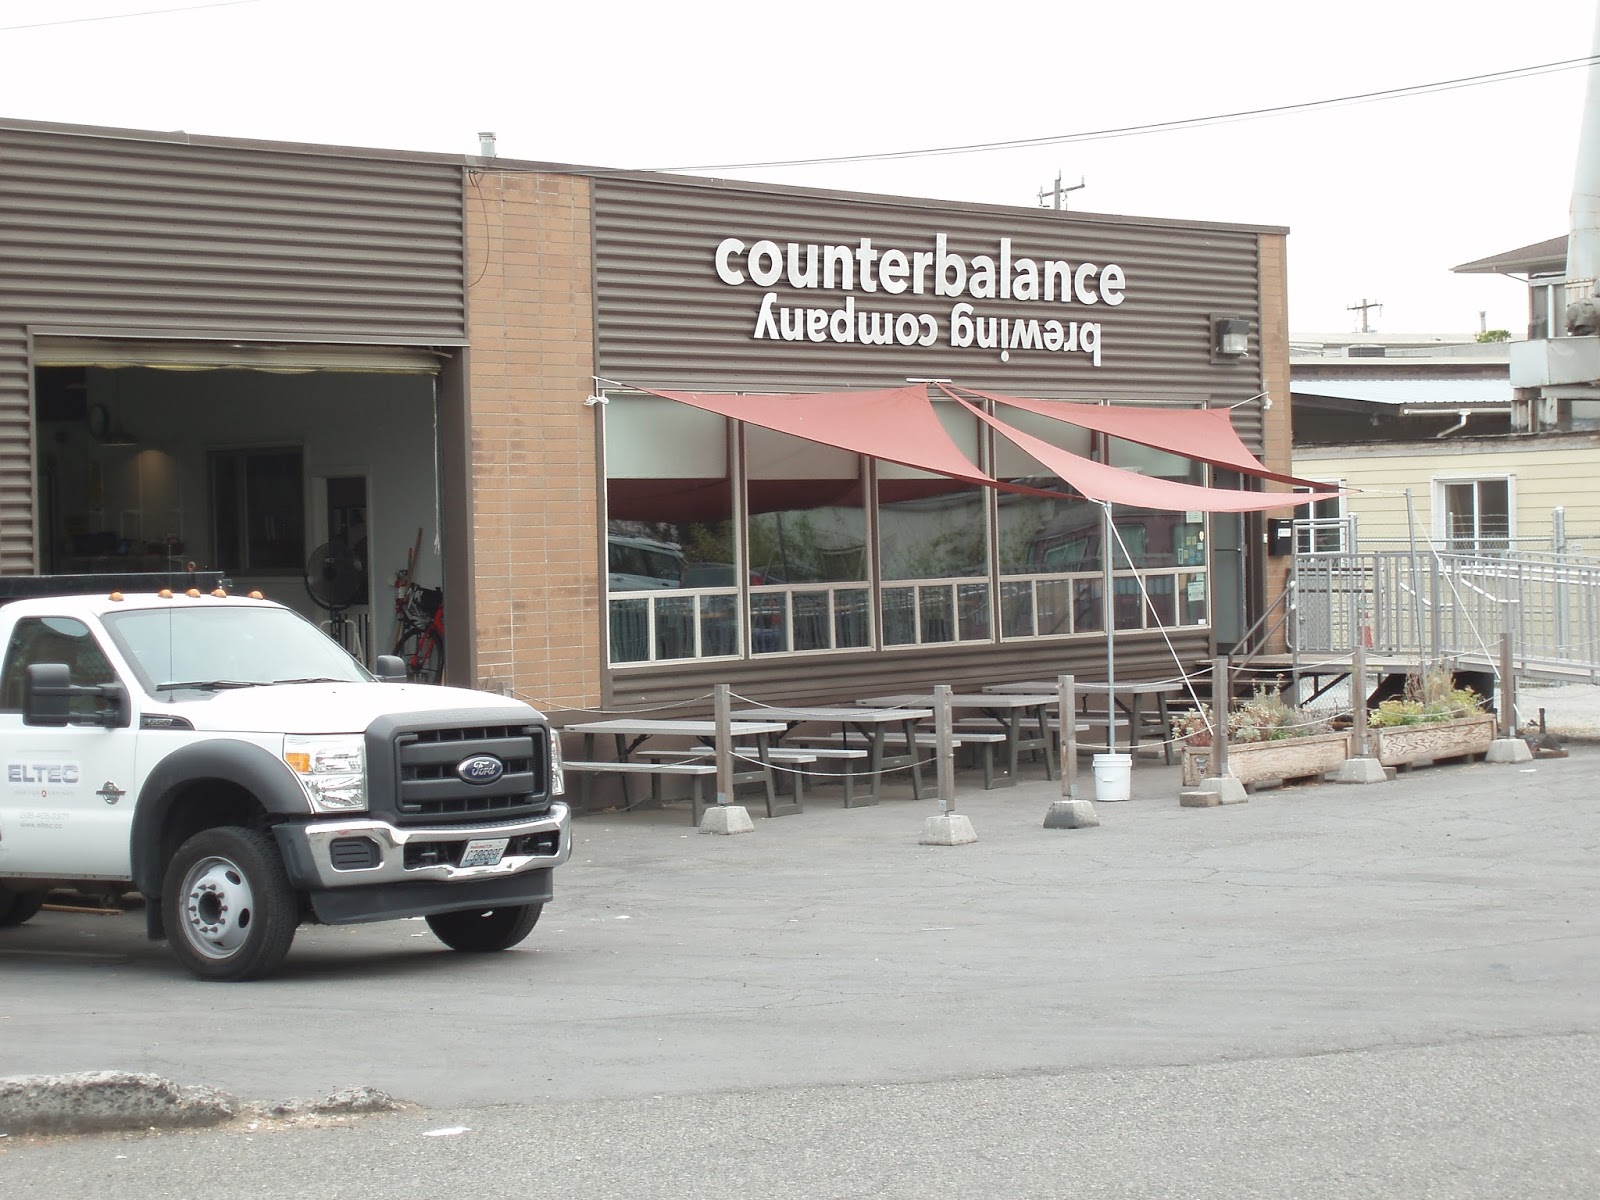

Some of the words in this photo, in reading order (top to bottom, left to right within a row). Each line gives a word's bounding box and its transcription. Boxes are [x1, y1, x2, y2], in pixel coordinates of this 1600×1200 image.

[715, 233, 1126, 306] counterbalance
[753, 292, 939, 347] company
[951, 302, 1102, 367] brewing
[8, 764, 79, 784] ELTEC
[471, 760, 496, 776] Ford
